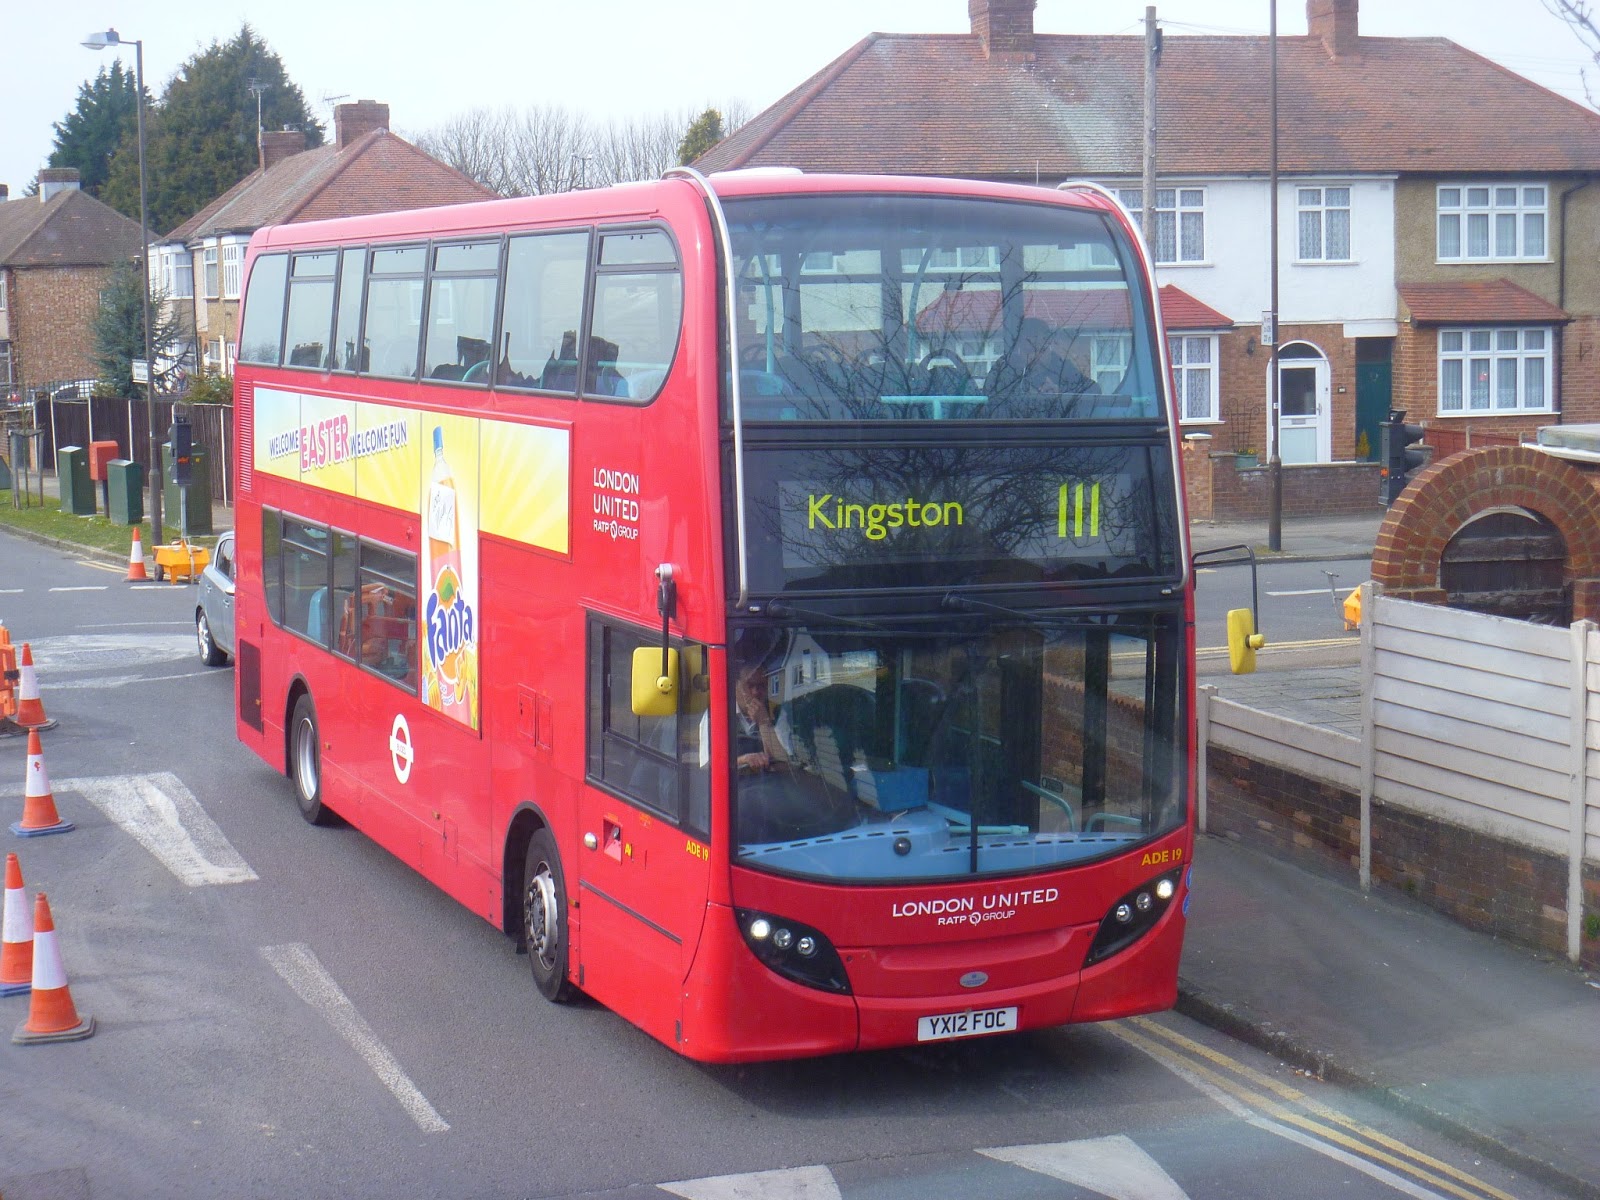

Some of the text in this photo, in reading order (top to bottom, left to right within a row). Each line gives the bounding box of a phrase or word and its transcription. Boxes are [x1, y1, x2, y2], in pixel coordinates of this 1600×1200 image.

[269, 414, 407, 469] WELCOME EASTER WELCOME FUN
[593, 467, 639, 495] LONDON
[593, 493, 639, 522] UNITED
[808, 493, 963, 540] Kingston
[1057, 482, 1099, 538] 111
[593, 519, 638, 540] RATP GROUP
[426, 589, 473, 669] Fanta
[686, 840, 709, 862] ADE 19
[1141, 848, 1182, 866] ADE 19
[892, 888, 1059, 917] LONDON UNITED
[937, 910, 1016, 926] RATP GROUP
[930, 1010, 1006, 1035] YX12 FOC
